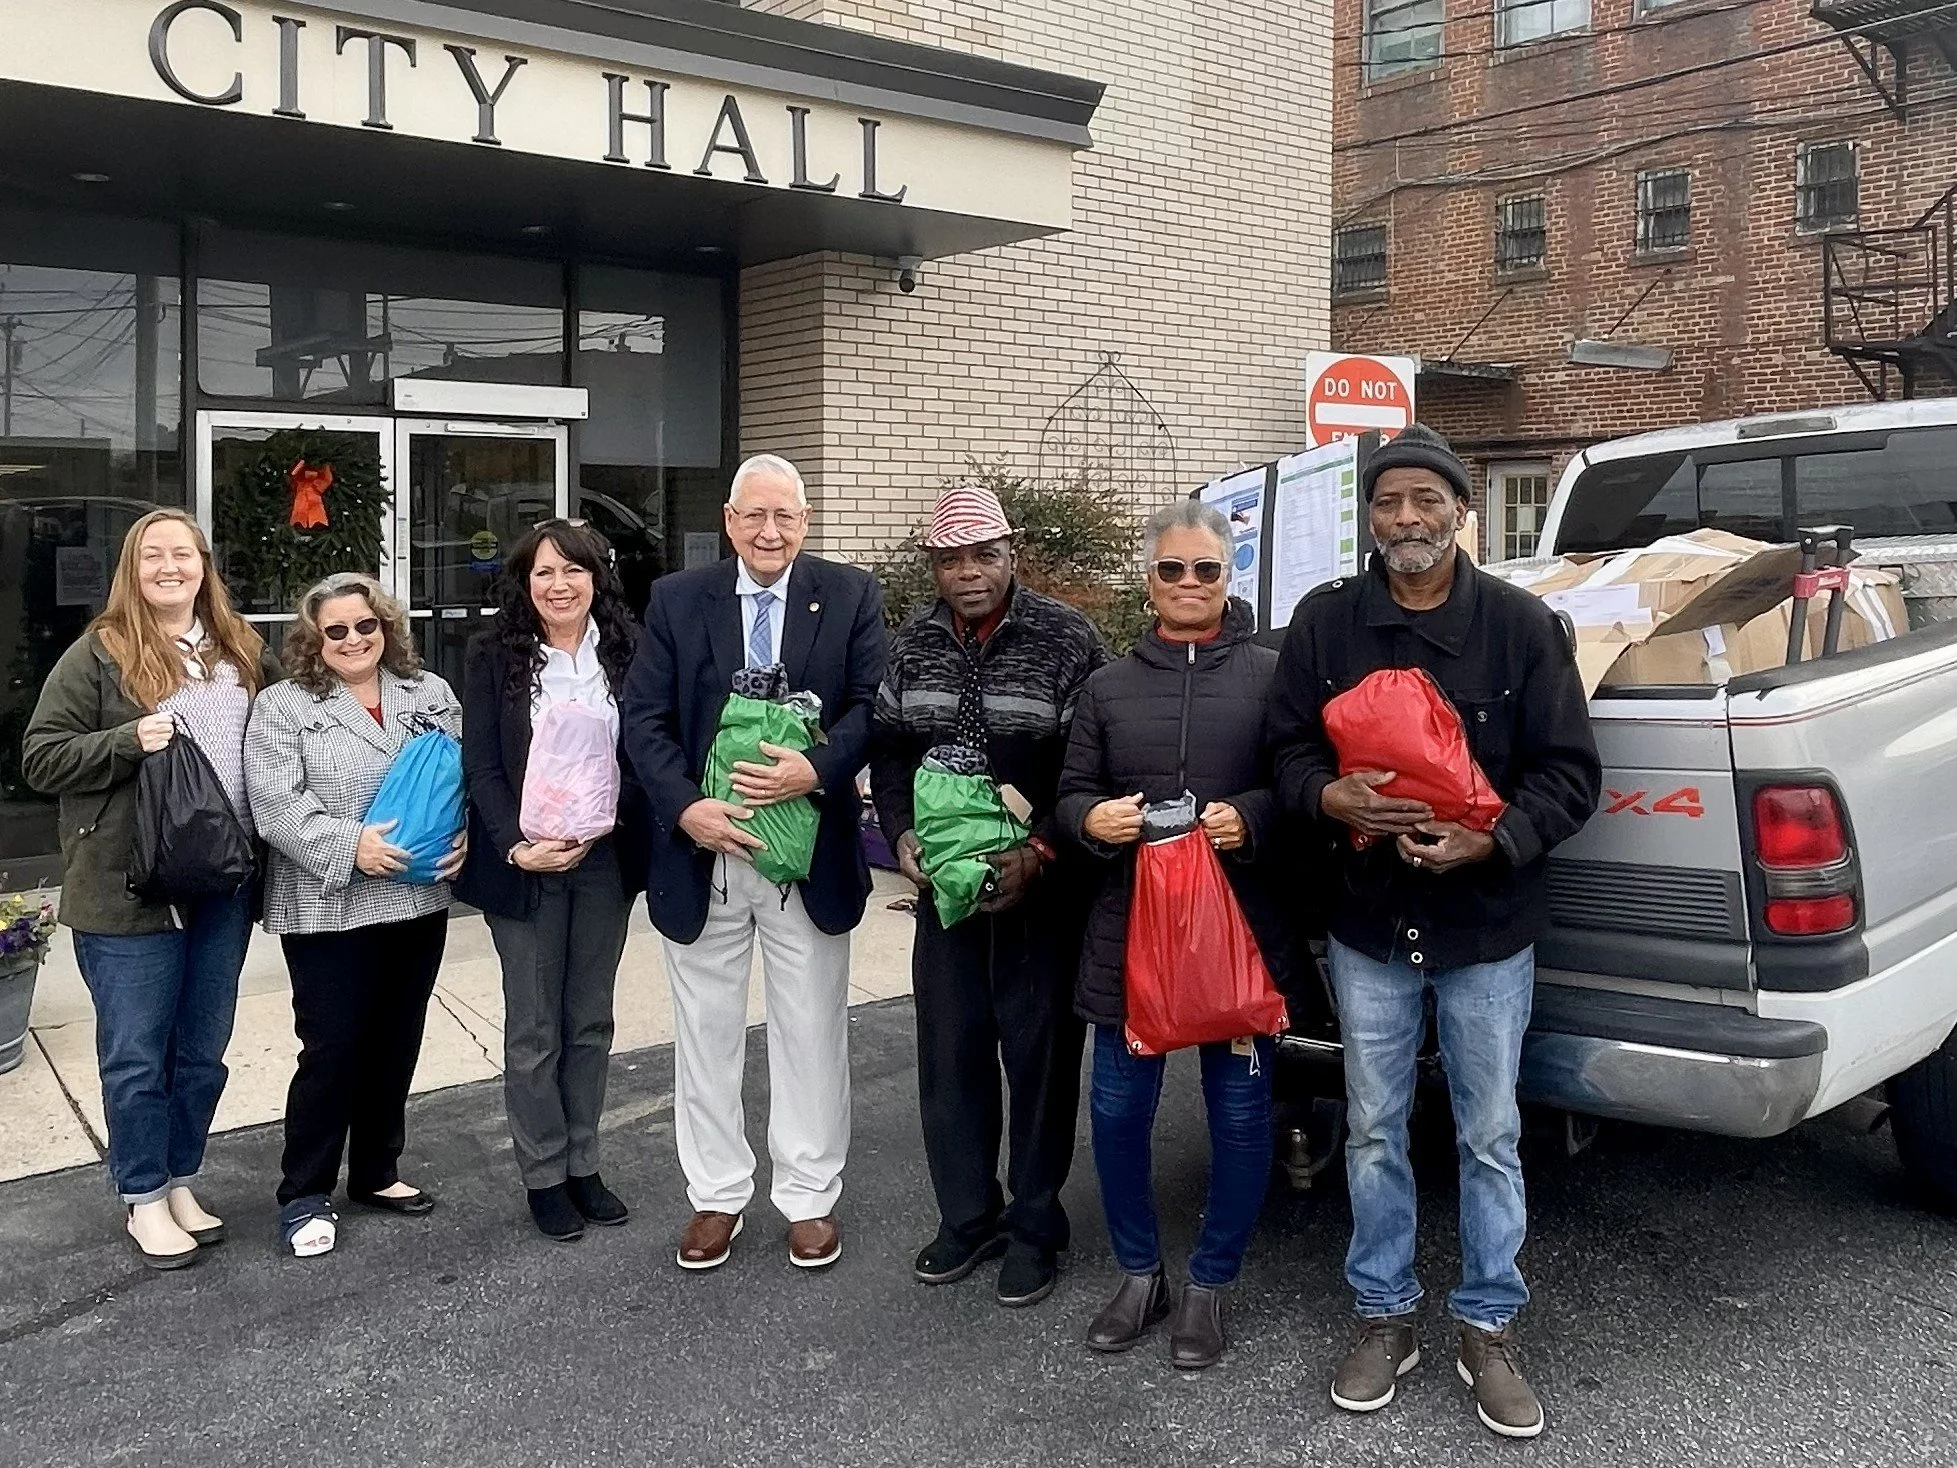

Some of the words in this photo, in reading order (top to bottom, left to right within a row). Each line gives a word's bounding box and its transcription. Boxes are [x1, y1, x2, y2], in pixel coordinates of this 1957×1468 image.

[148, 0, 528, 145] CITY
[602, 72, 907, 203] HALL
[1324, 377, 1350, 397] DO
[1361, 379, 1398, 400] NOT
